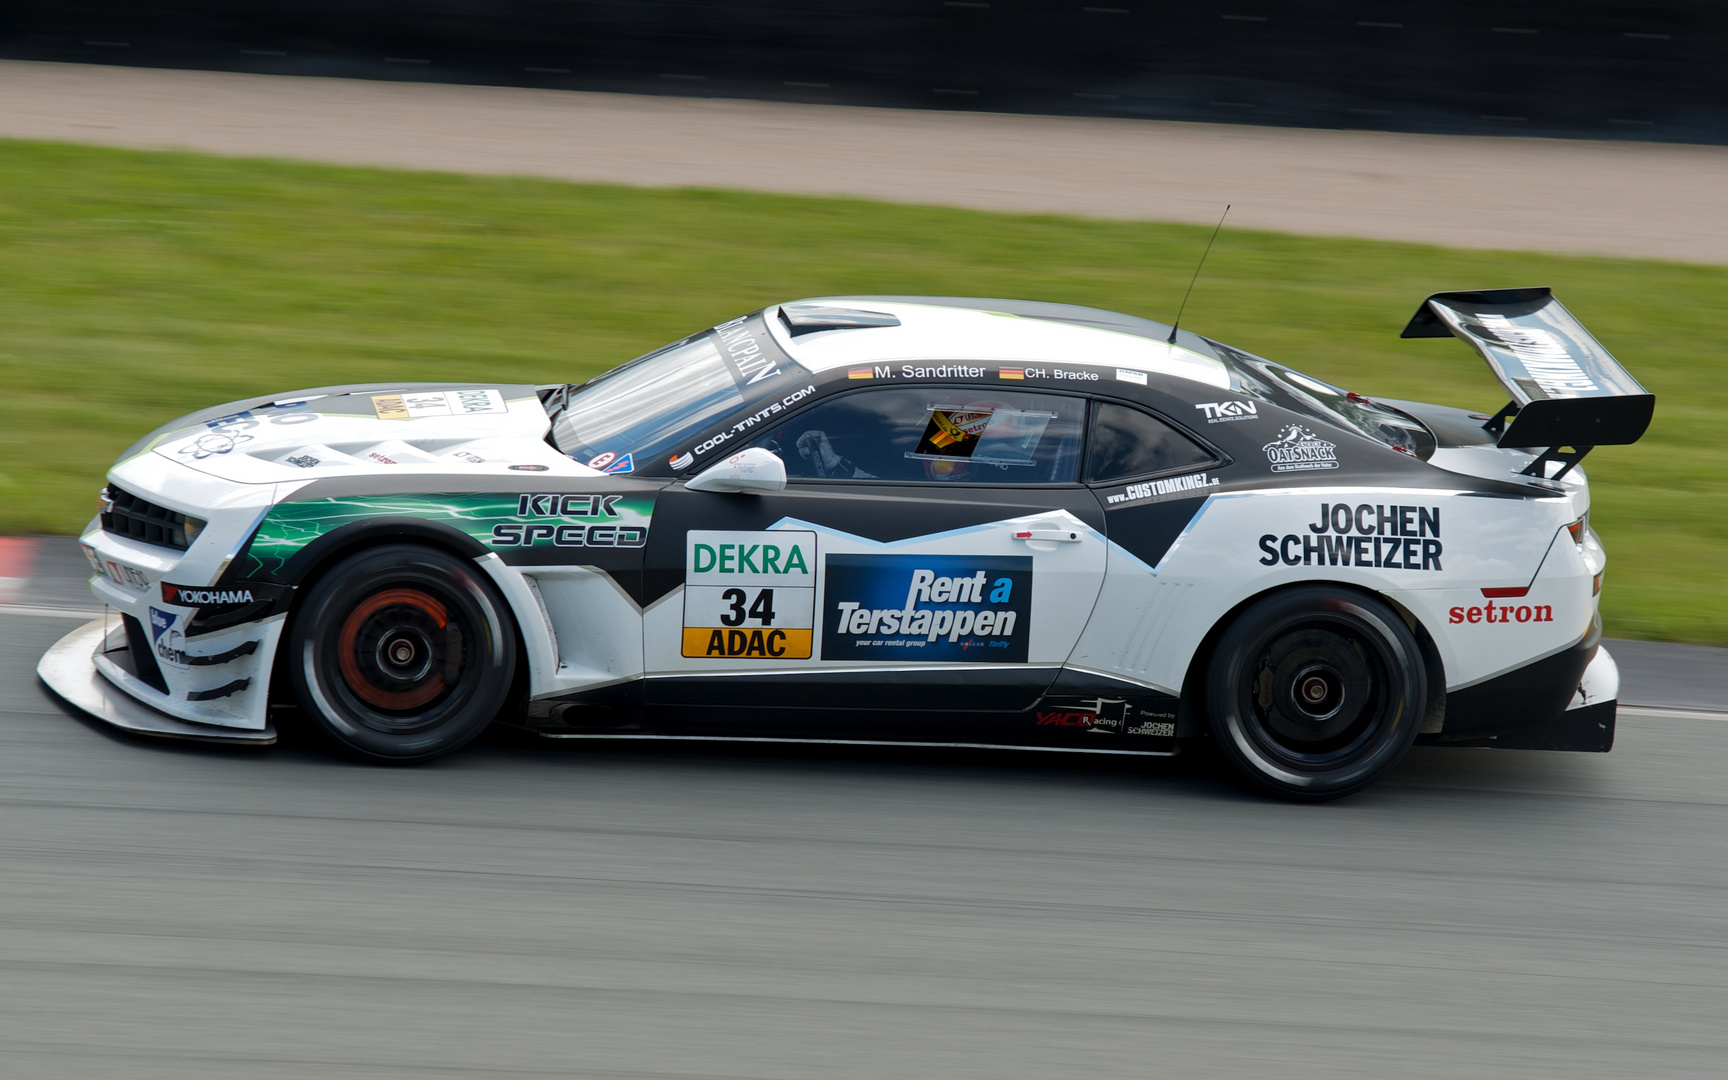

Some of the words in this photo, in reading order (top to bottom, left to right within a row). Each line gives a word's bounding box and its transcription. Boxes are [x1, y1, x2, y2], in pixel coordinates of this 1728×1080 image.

[874, 366, 896, 379] M.
[901, 364, 987, 378] Sandritter
[1024, 367, 1050, 379] CH.
[1053, 369, 1099, 381] Bracke
[405, 396, 447, 409] 34
[456, 389, 494, 413] DEKRA
[517, 493, 624, 518] KICK
[1308, 502, 1441, 539] JOCHEN
[490, 523, 648, 549] SPEED
[693, 543, 809, 575] DEKRA
[1258, 533, 1444, 572] SCHWEIZER
[177, 589, 254, 604] YOKOHAMA
[905, 569, 987, 603] Rent
[989, 577, 1013, 604] a
[150, 607, 167, 629] blue
[720, 588, 776, 627] 34
[1448, 600, 1554, 624] setron
[837, 601, 1017, 643] Terstappen
[705, 629, 787, 657] ADAC
[855, 639, 872, 648] your
[872, 639, 884, 647] car
[885, 638, 906, 647] rental
[905, 640, 926, 648] group
[1140, 709, 1167, 719] Powered
[1141, 721, 1175, 731] JOCHEN
[1126, 726, 1175, 737] SCHWEIZER
